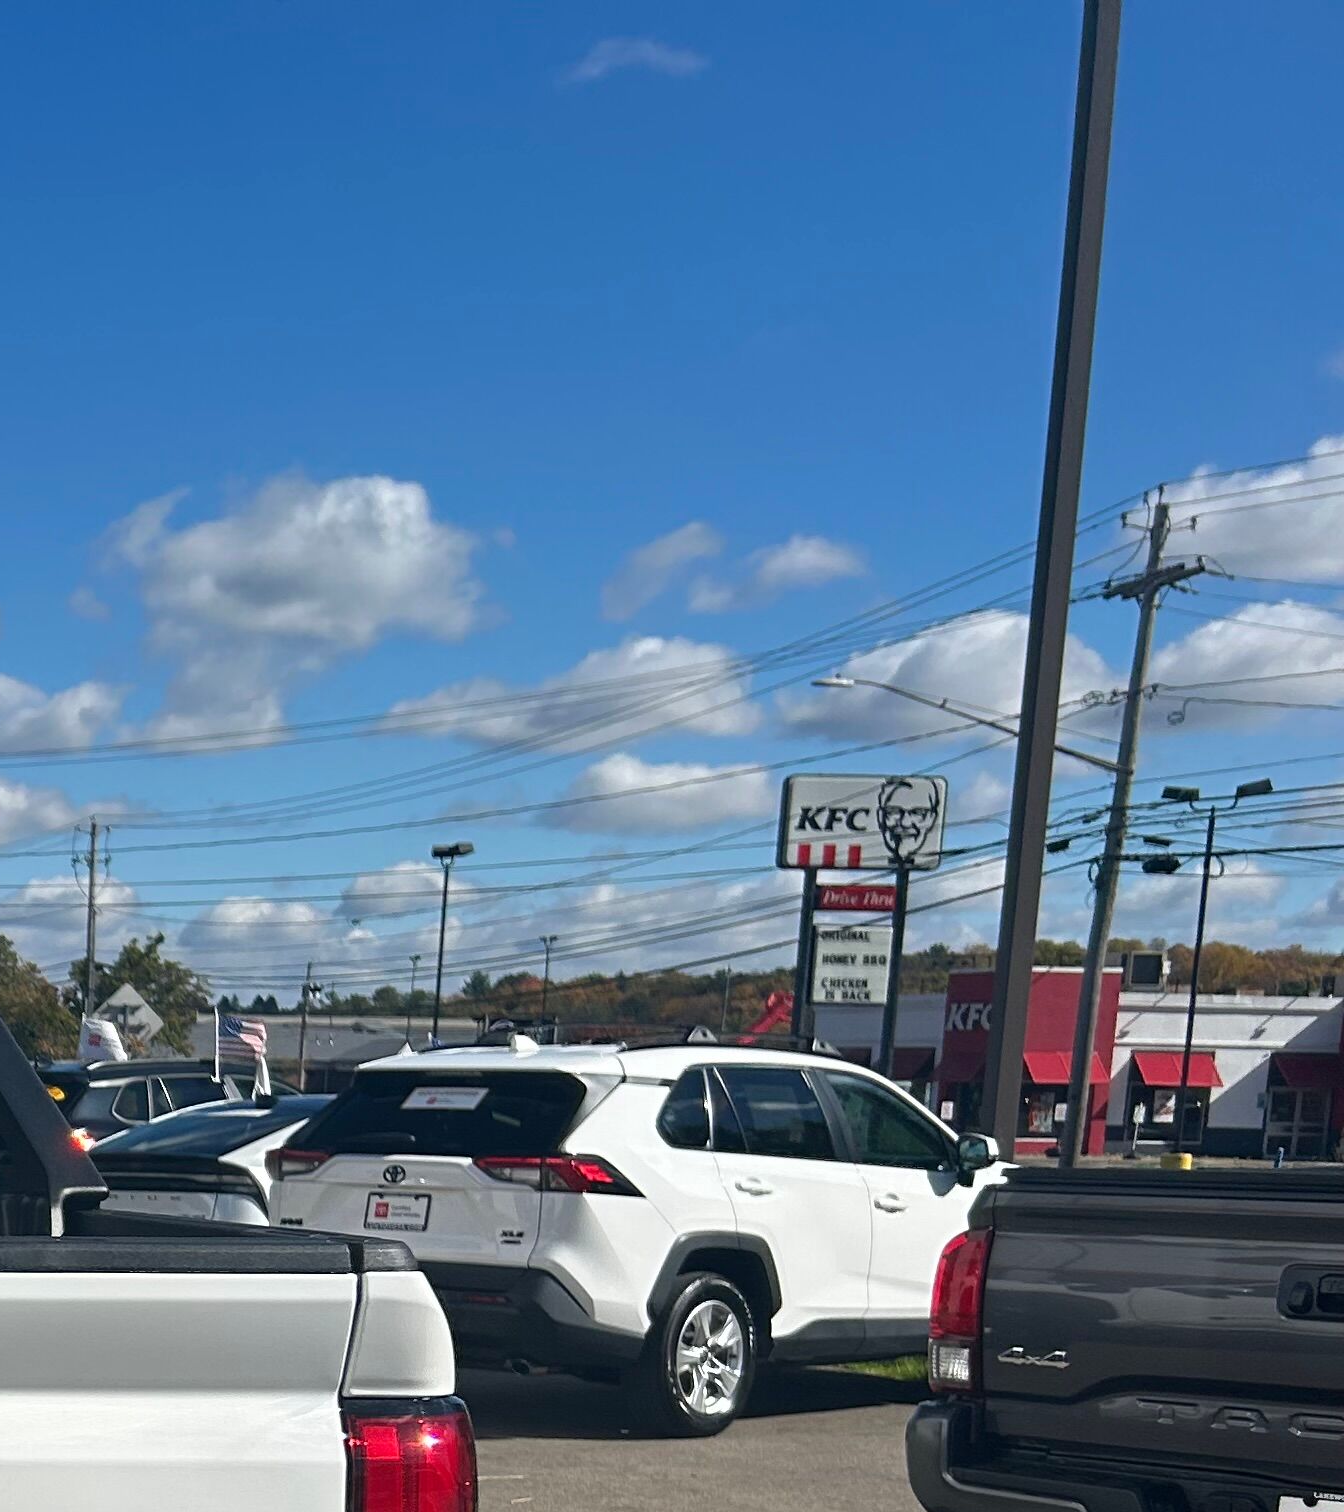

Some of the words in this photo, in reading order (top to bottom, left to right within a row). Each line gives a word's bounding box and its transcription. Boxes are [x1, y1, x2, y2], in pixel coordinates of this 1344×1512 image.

[795, 806, 870, 831] KFC
[822, 890, 859, 906] Drive
[820, 930, 870, 943] ORIGINAL
[822, 953, 857, 965] HONEY
[821, 976, 868, 989] CHICKEN
[824, 990, 834, 1000] IS
[842, 990, 871, 1001] BACK
